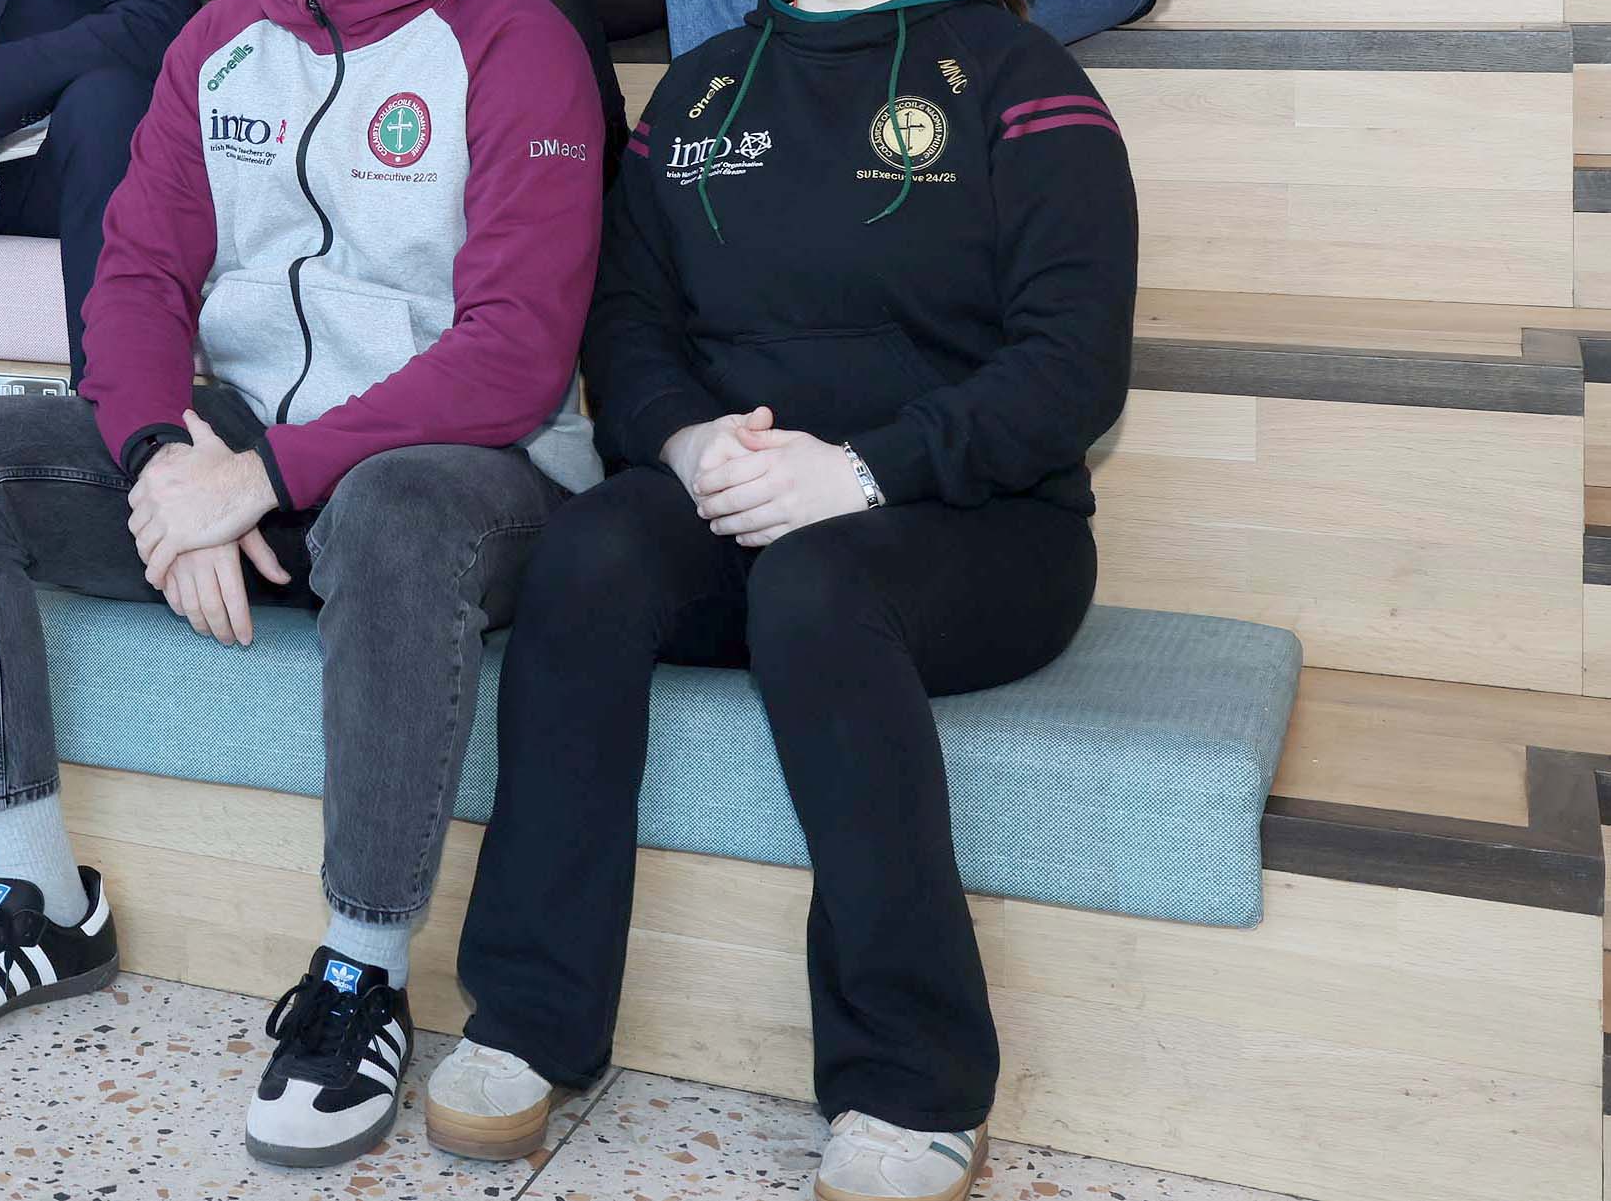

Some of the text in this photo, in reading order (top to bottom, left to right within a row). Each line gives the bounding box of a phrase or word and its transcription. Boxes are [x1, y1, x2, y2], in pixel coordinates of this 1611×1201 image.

[208, 108, 271, 145] into
[666, 136, 733, 168] into
[350, 168, 438, 183] SU Executive 22/23
[856, 169, 957, 183] SU Execuve 24/25
